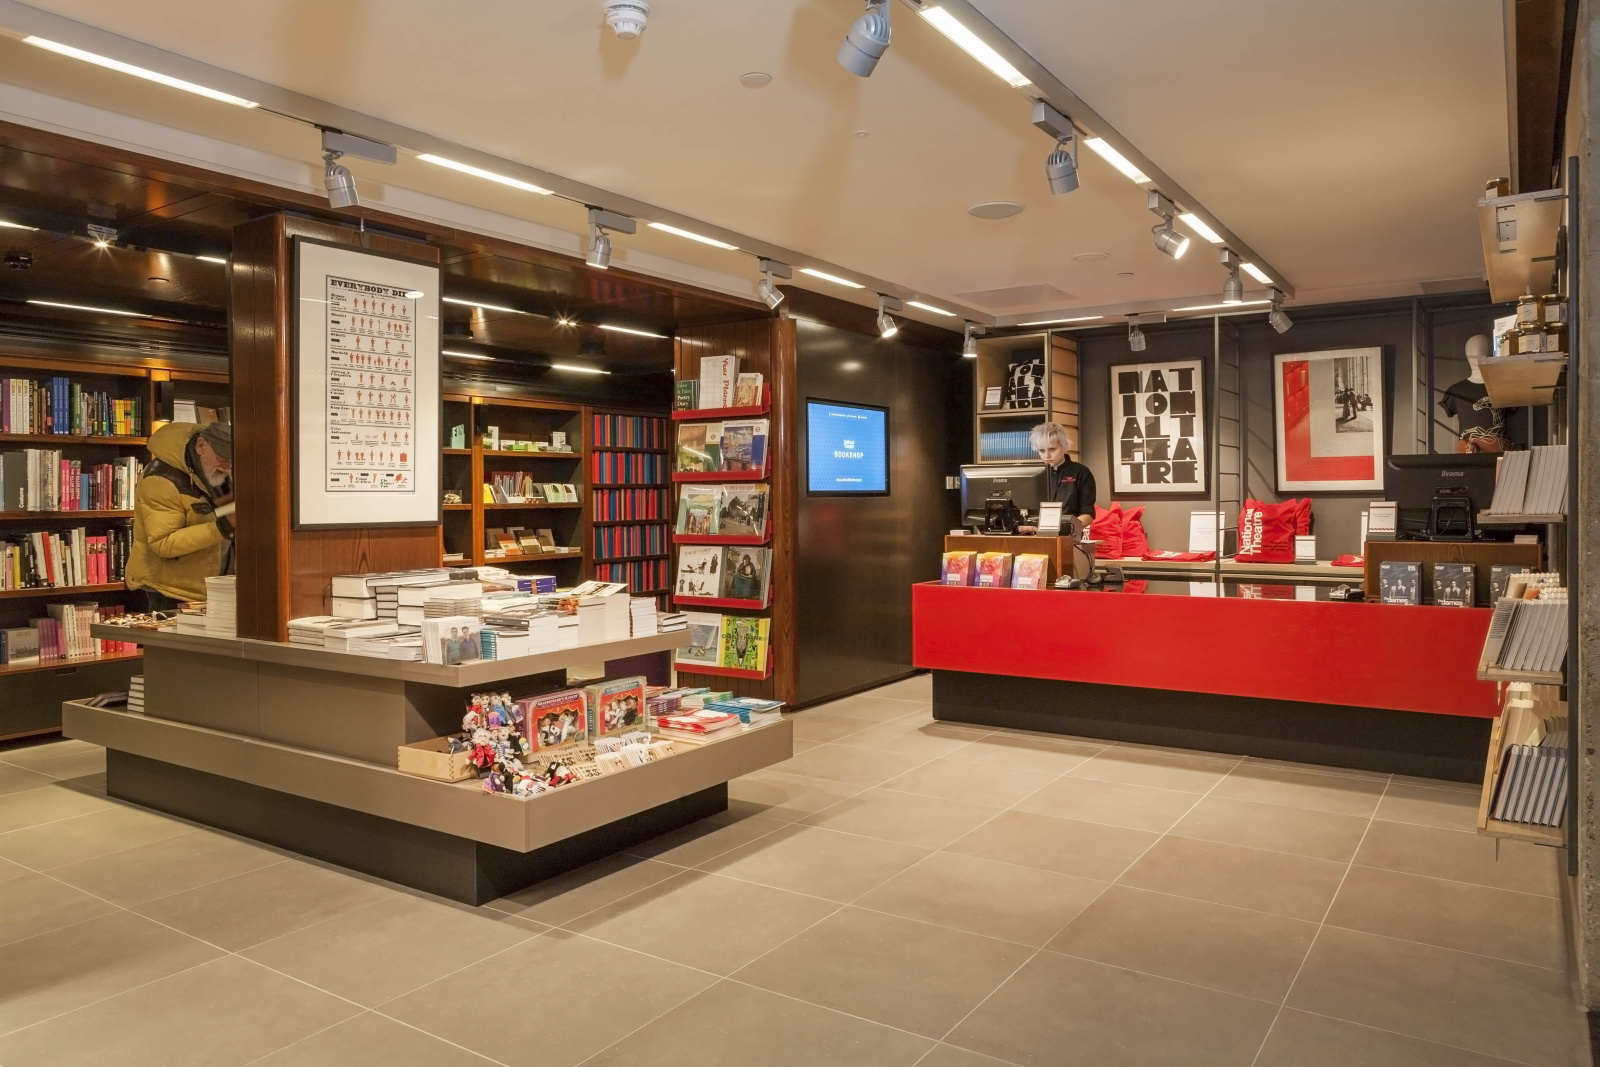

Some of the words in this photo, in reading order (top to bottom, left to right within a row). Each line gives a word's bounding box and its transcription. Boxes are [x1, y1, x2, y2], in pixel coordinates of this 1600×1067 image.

[331, 279, 389, 294] EVERYBODY
[834, 451, 864, 459] BOOKSHOP
[1239, 508, 1255, 555] National
[1250, 511, 1263, 555] Theatre
